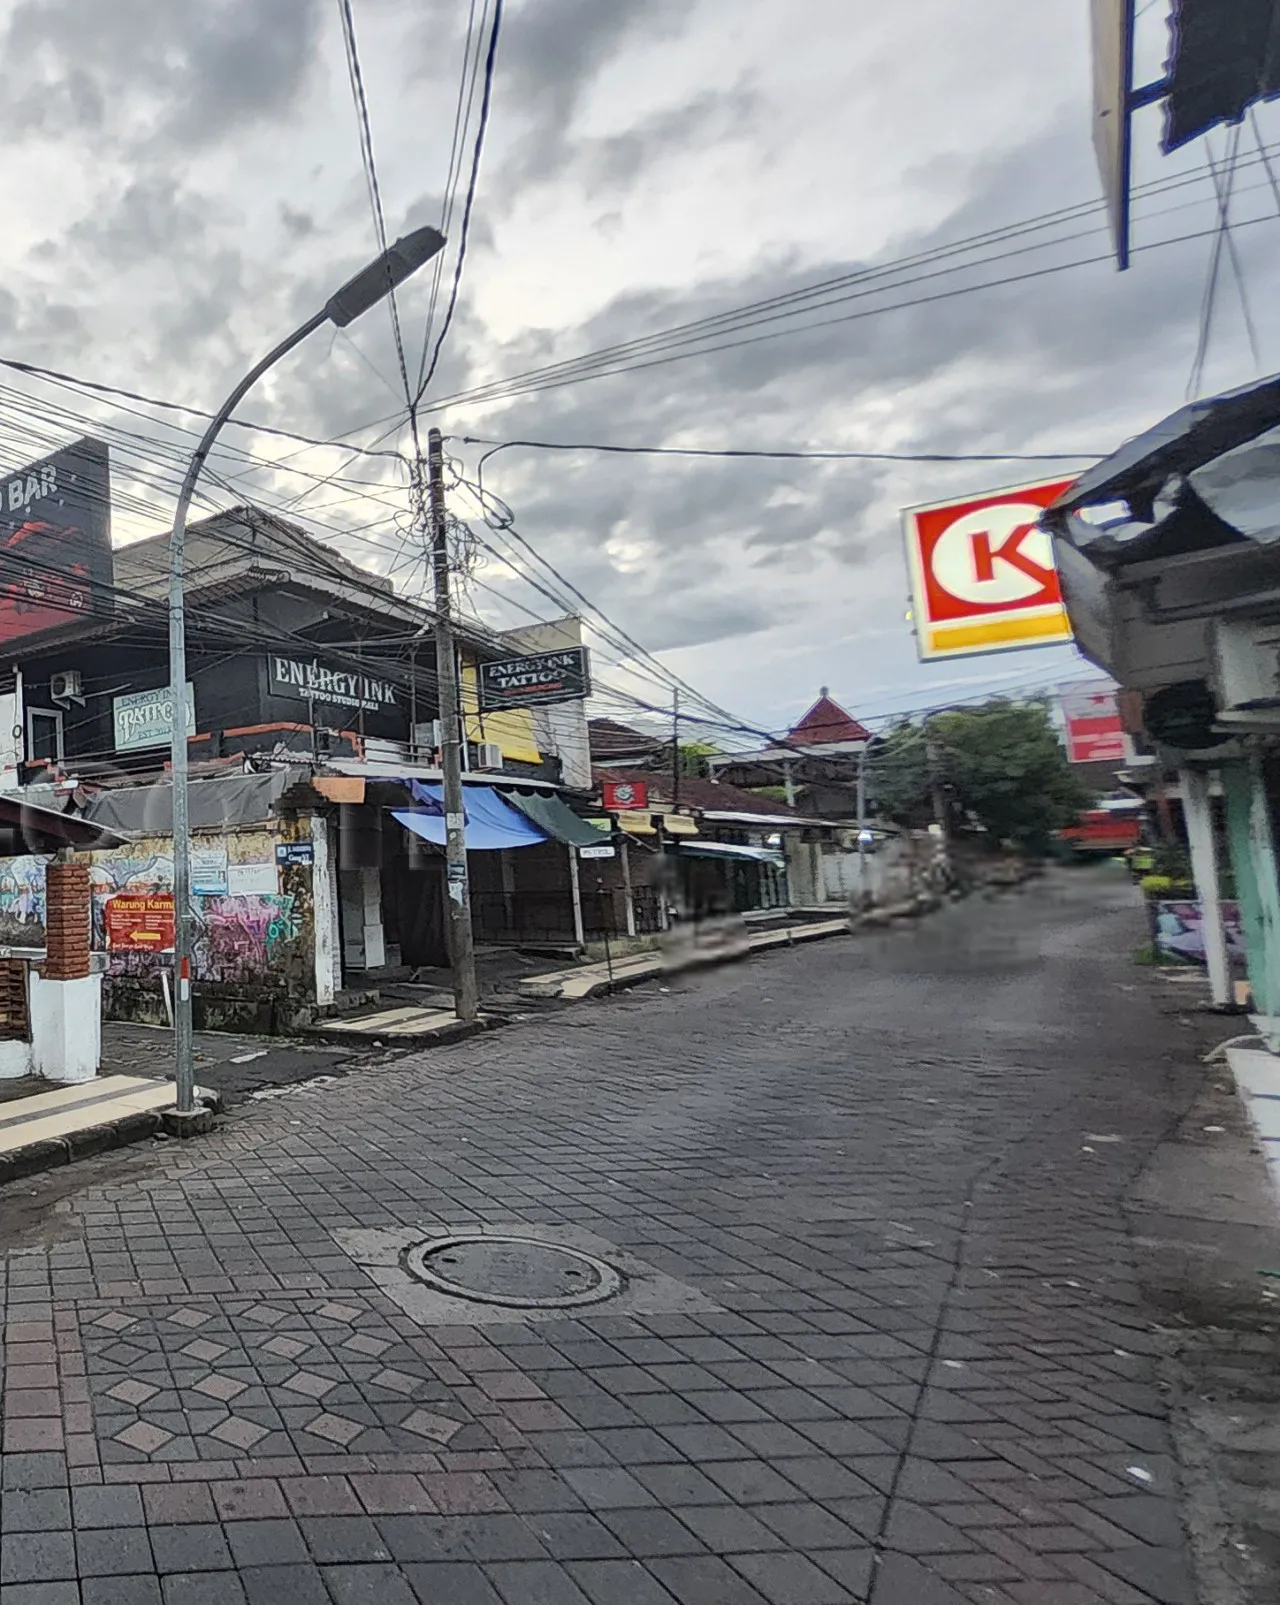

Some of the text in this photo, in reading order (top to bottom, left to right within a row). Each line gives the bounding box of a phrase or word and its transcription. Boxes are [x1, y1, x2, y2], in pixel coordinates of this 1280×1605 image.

[8, 465, 58, 512] BAR
[489, 660, 545, 677] ENERGY
[275, 657, 397, 704] ENERGY INK
[497, 670, 567, 688] TATTOO
[299, 688, 331, 702] TATTOO
[332, 695, 360, 707] STUDIO
[118, 700, 193, 743] TATTO
[112, 899, 146, 911] Warung
